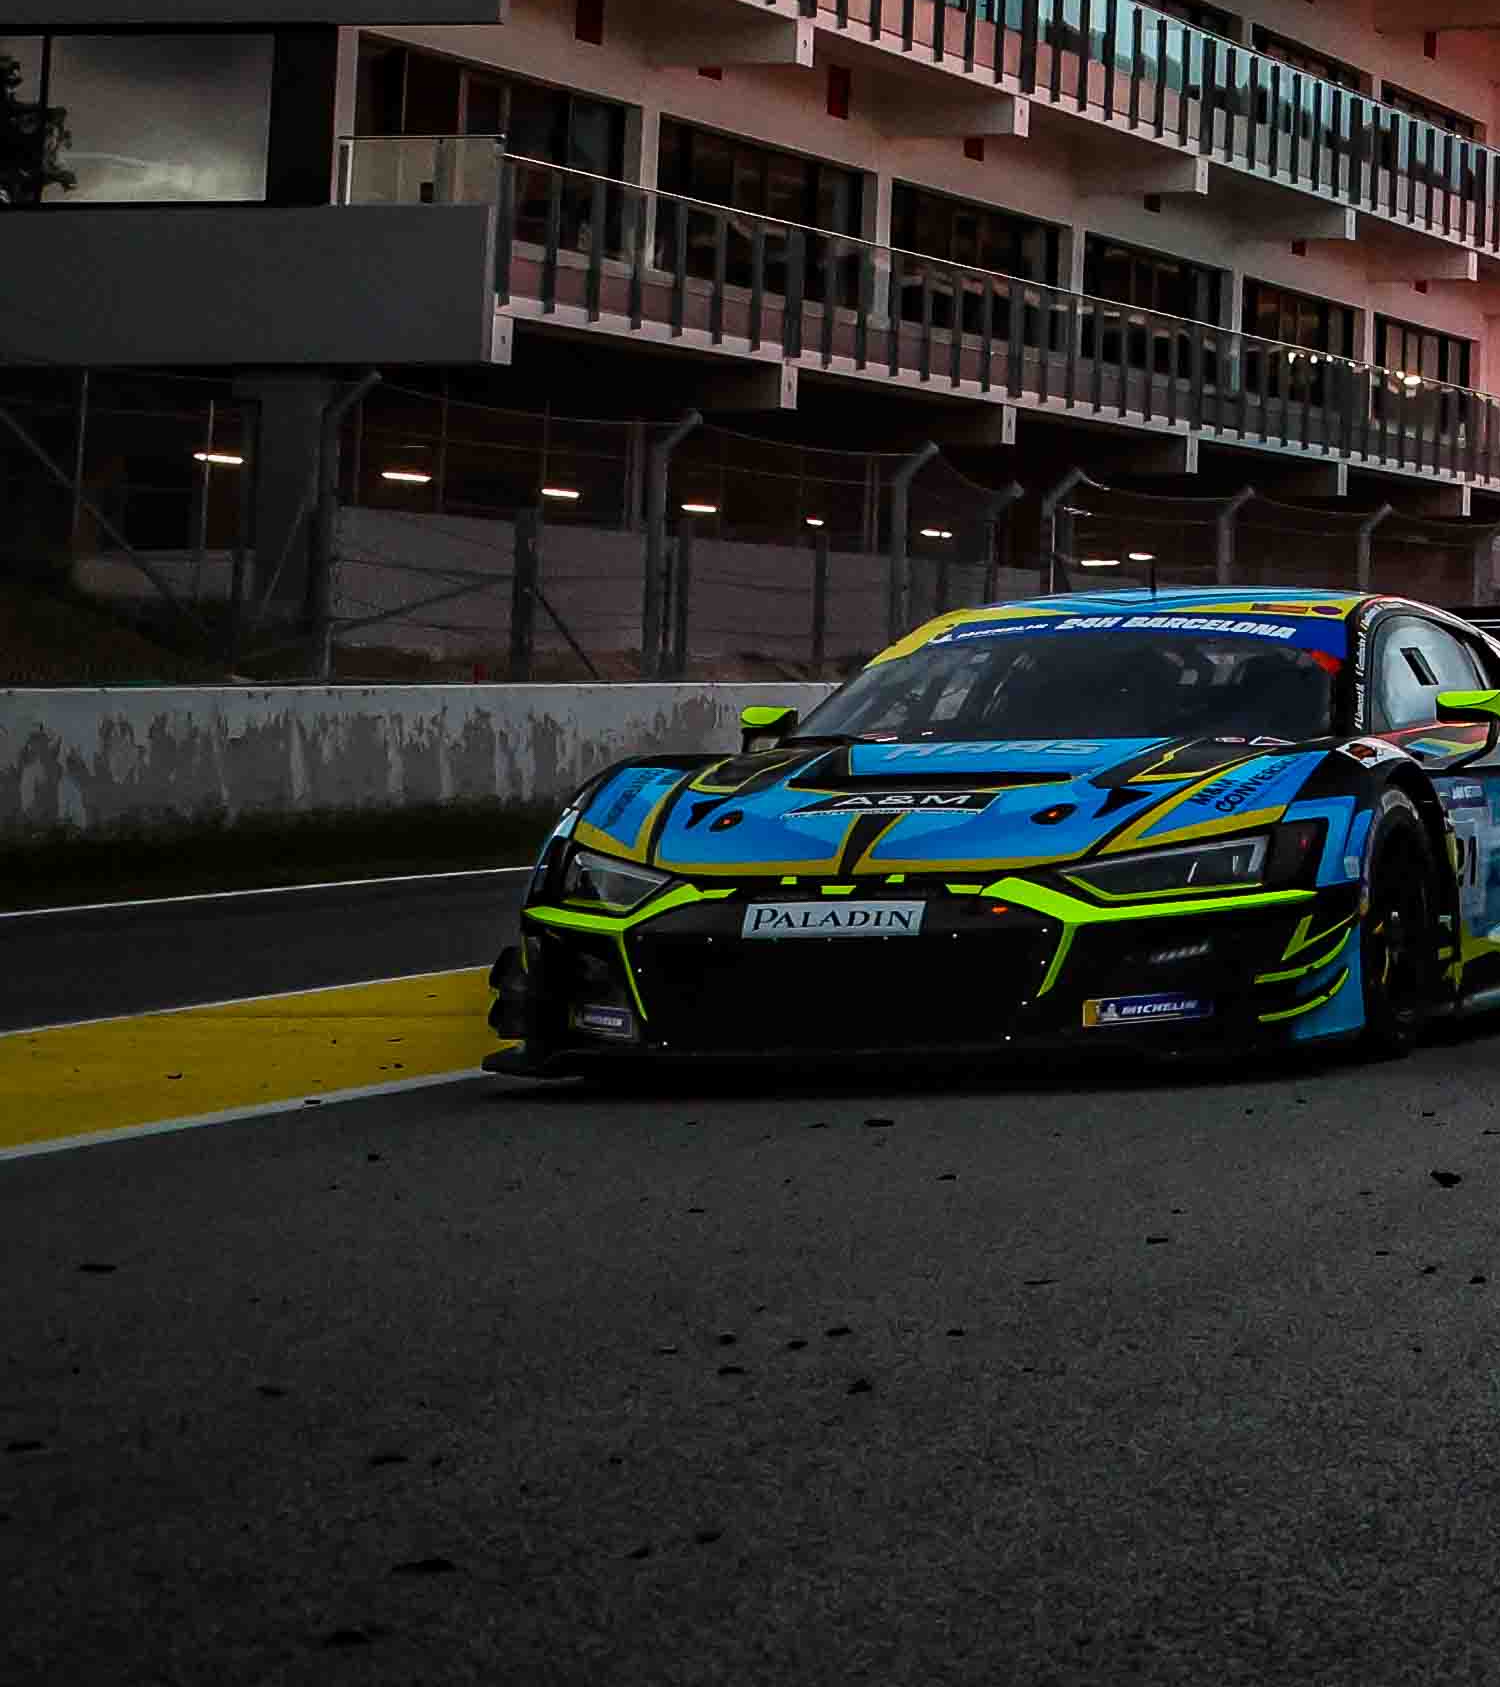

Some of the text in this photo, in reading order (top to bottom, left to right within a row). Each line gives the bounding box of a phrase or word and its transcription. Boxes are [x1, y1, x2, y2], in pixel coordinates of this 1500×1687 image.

[1054, 616, 1123, 630] 24H
[1122, 616, 1297, 639] BARCELONA
[830, 793, 973, 807] A&M
[752, 907, 914, 933] PALADIN
[1121, 999, 1199, 1016] MICHELIN
